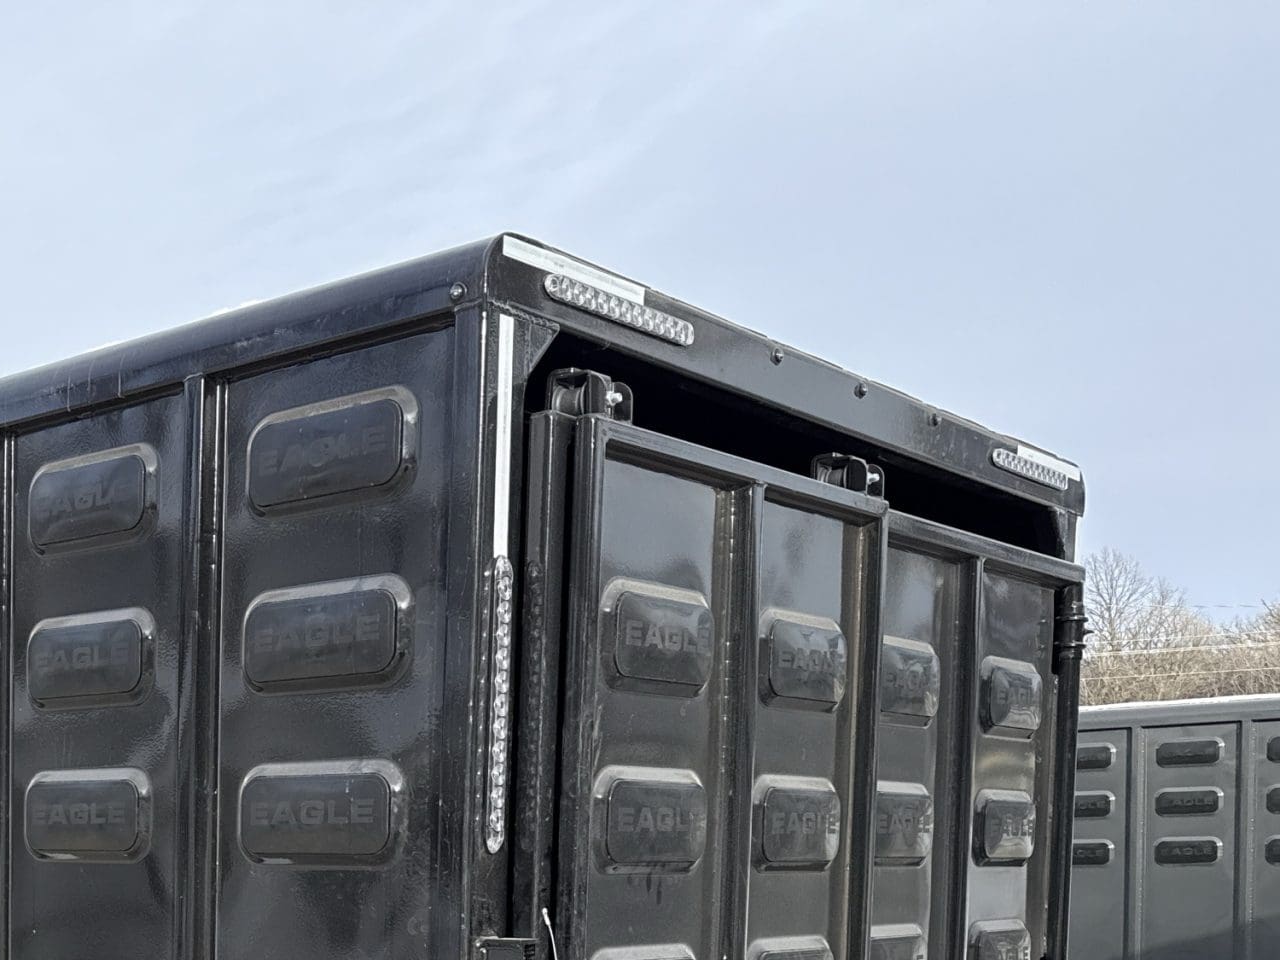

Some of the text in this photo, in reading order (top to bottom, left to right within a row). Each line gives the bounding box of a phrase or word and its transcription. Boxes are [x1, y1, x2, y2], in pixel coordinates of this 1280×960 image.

[259, 426, 386, 474] EAGLE
[255, 615, 380, 654] EAGLE
[625, 619, 711, 651] EAGLE
[35, 641, 129, 673] EAGLE
[32, 802, 126, 827] EAGLE
[249, 797, 375, 827] EAGLE
[772, 812, 840, 835] EAGLE
